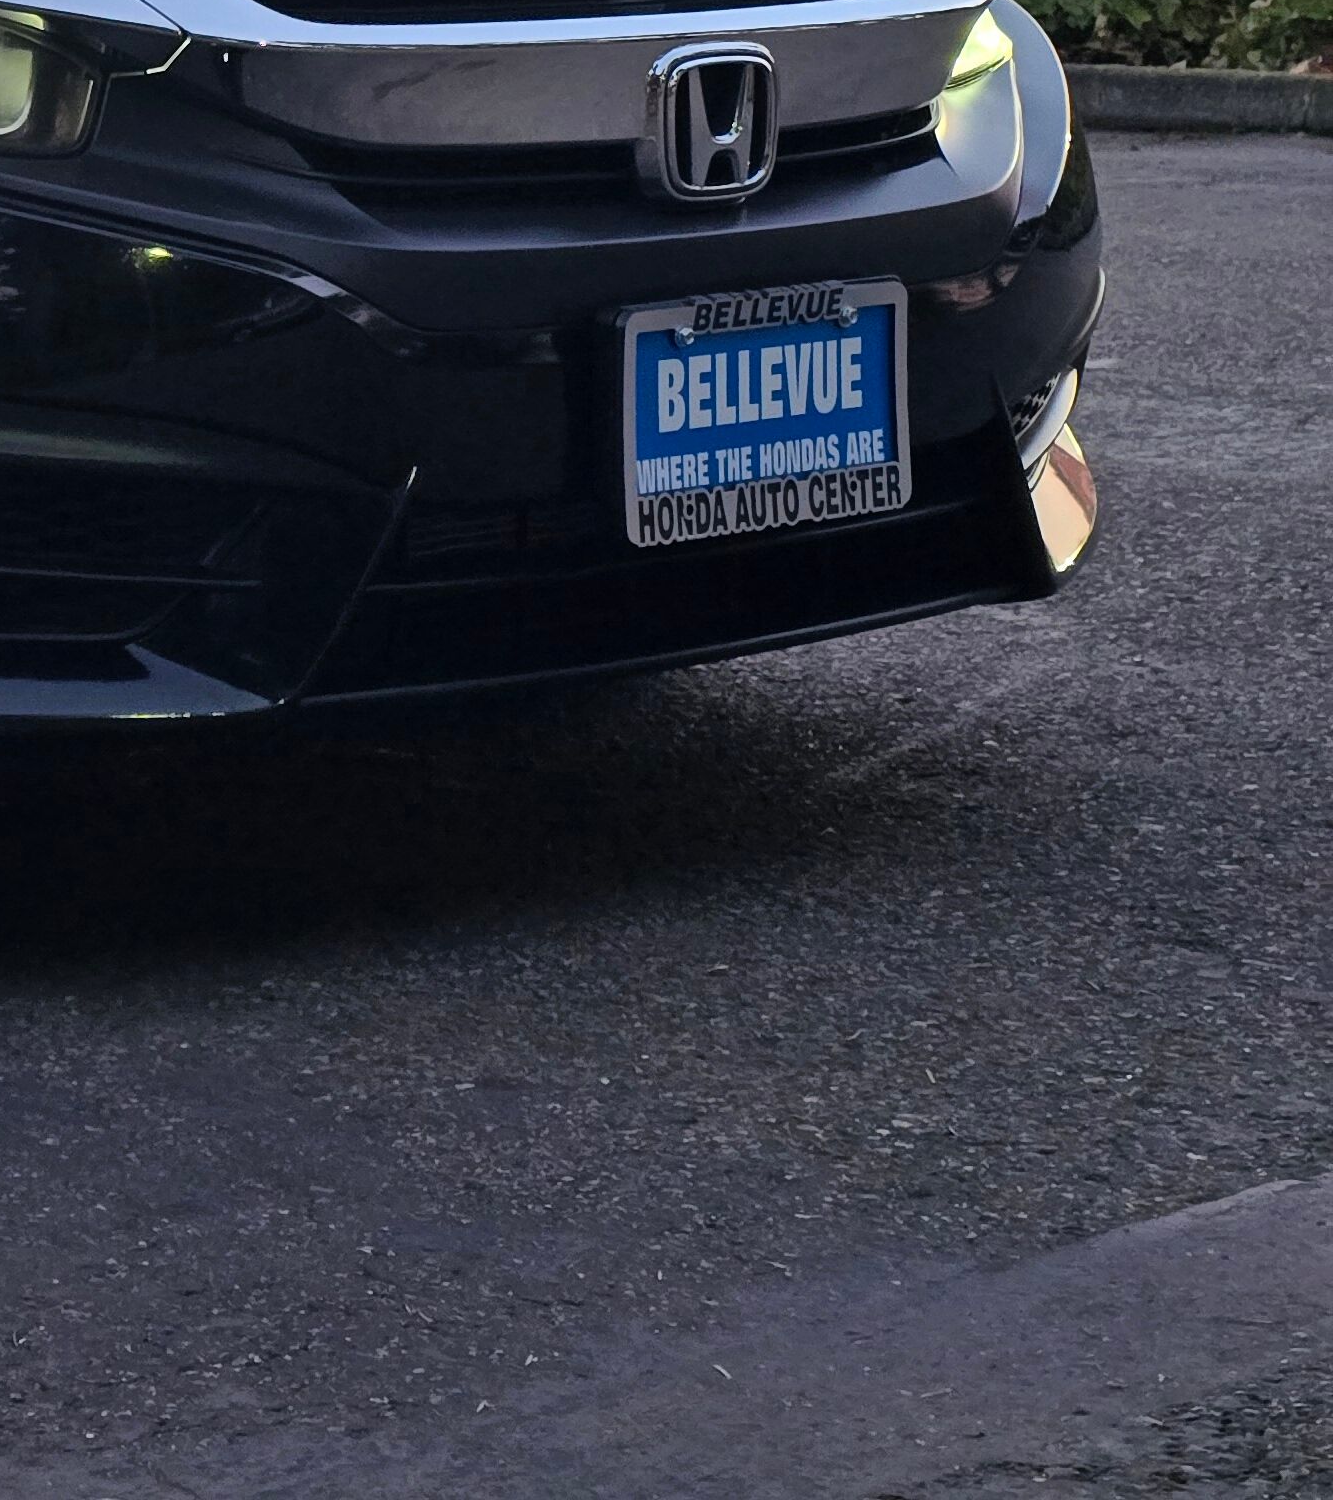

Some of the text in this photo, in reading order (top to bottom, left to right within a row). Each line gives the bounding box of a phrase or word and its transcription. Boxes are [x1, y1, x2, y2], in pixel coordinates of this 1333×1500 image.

[693, 287, 844, 331] BELLEVUE
[657, 336, 863, 433] BELLEVUE
[636, 428, 885, 495] WHERE THE HONDAS ARE
[638, 465, 902, 543] HONDA AUTO CENTER
